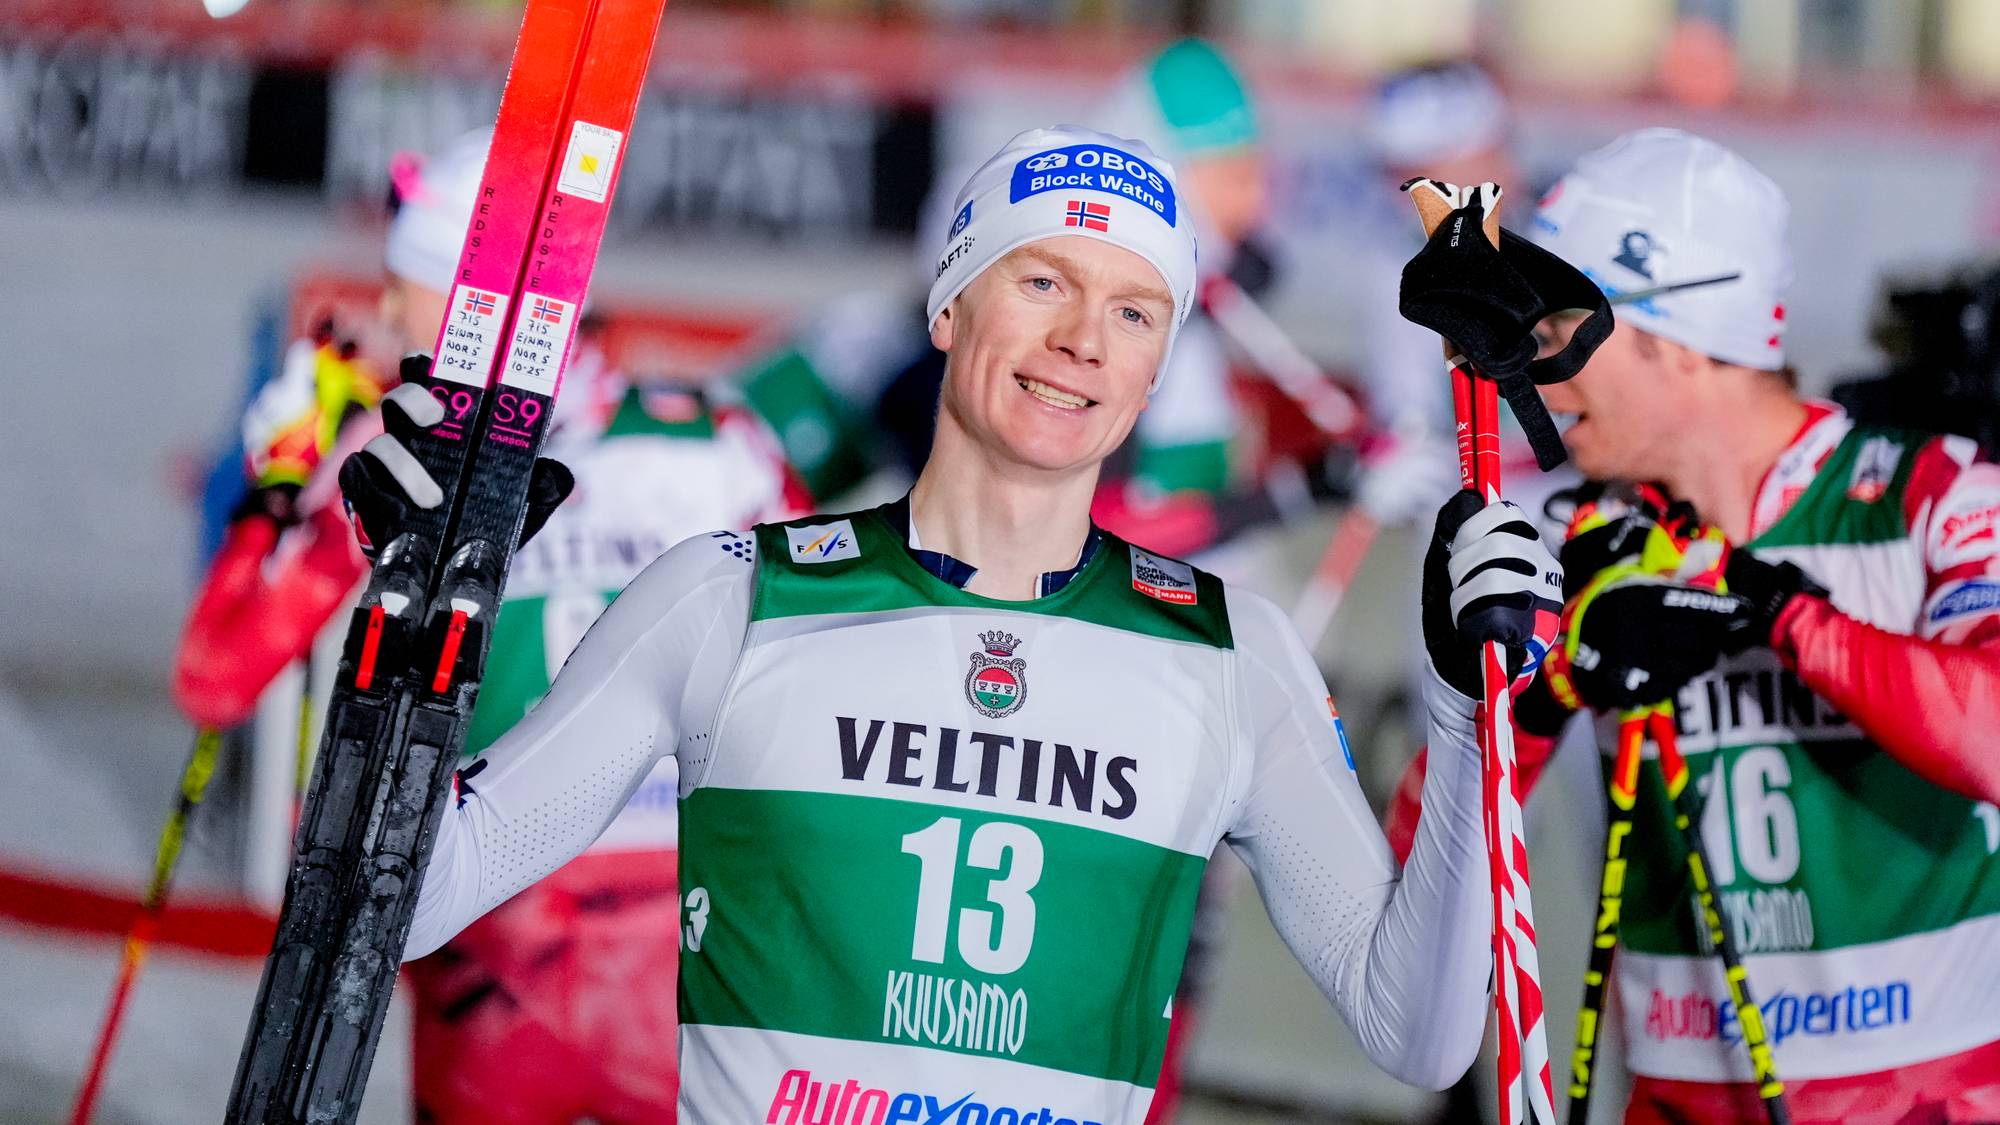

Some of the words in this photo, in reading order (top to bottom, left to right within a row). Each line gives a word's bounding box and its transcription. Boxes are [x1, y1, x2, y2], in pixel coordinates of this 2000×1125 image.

[1030, 173, 1094, 192] Block
[1099, 174, 1165, 213] Watne
[1075, 150, 1165, 194] OBOS
[447, 325, 483, 343] EINAR
[517, 333, 552, 350] EINAR
[494, 393, 541, 428] S9
[431, 428, 462, 441] RBON
[489, 432, 530, 448] CARBON
[836, 716, 1138, 820] VELTINS
[1696, 746, 1801, 886] 16
[901, 816, 1045, 975] 13
[679, 886, 710, 954] 3
[881, 970, 1028, 1055] KUUSAMO
